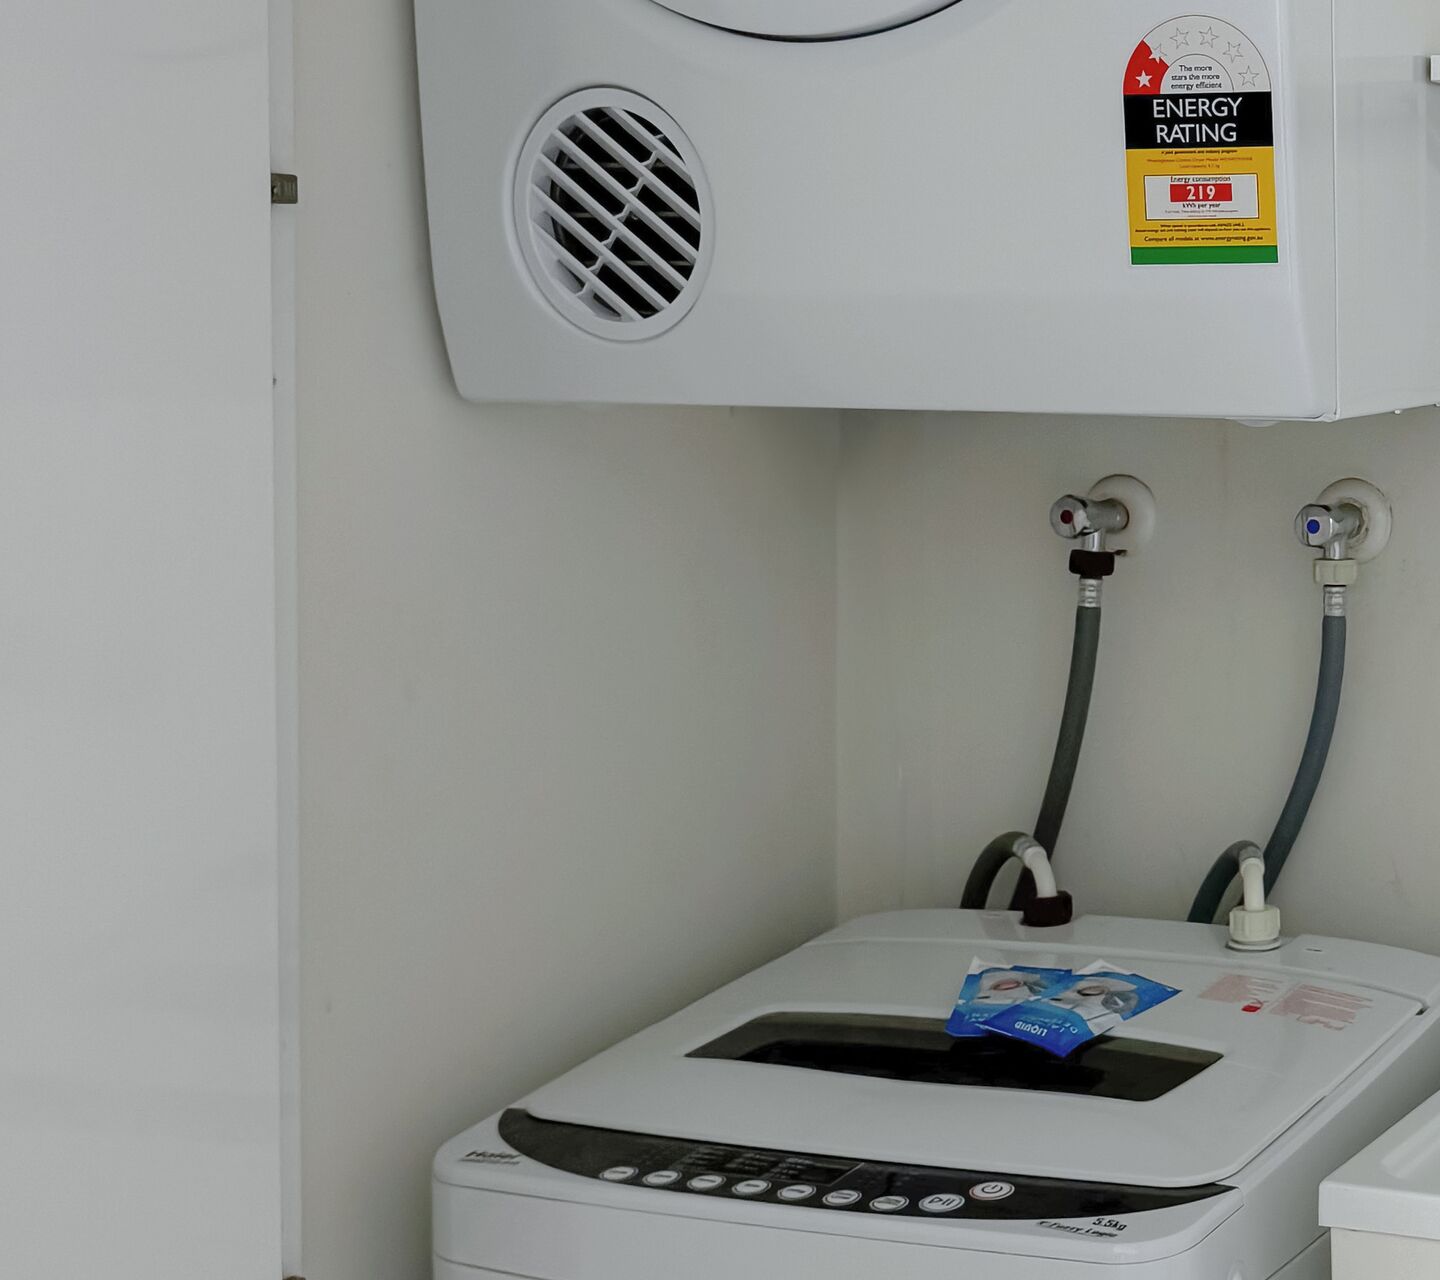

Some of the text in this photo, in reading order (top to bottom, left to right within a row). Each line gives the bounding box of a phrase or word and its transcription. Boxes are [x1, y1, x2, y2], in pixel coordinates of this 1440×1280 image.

[1179, 64, 1192, 72] The
[1152, 97, 1242, 118] ENERGY
[1156, 123, 1236, 144] RATING
[1170, 176, 1190, 184] Energy
[1186, 185, 1216, 200] 219
[1014, 1021, 1048, 1036] LIQUID
